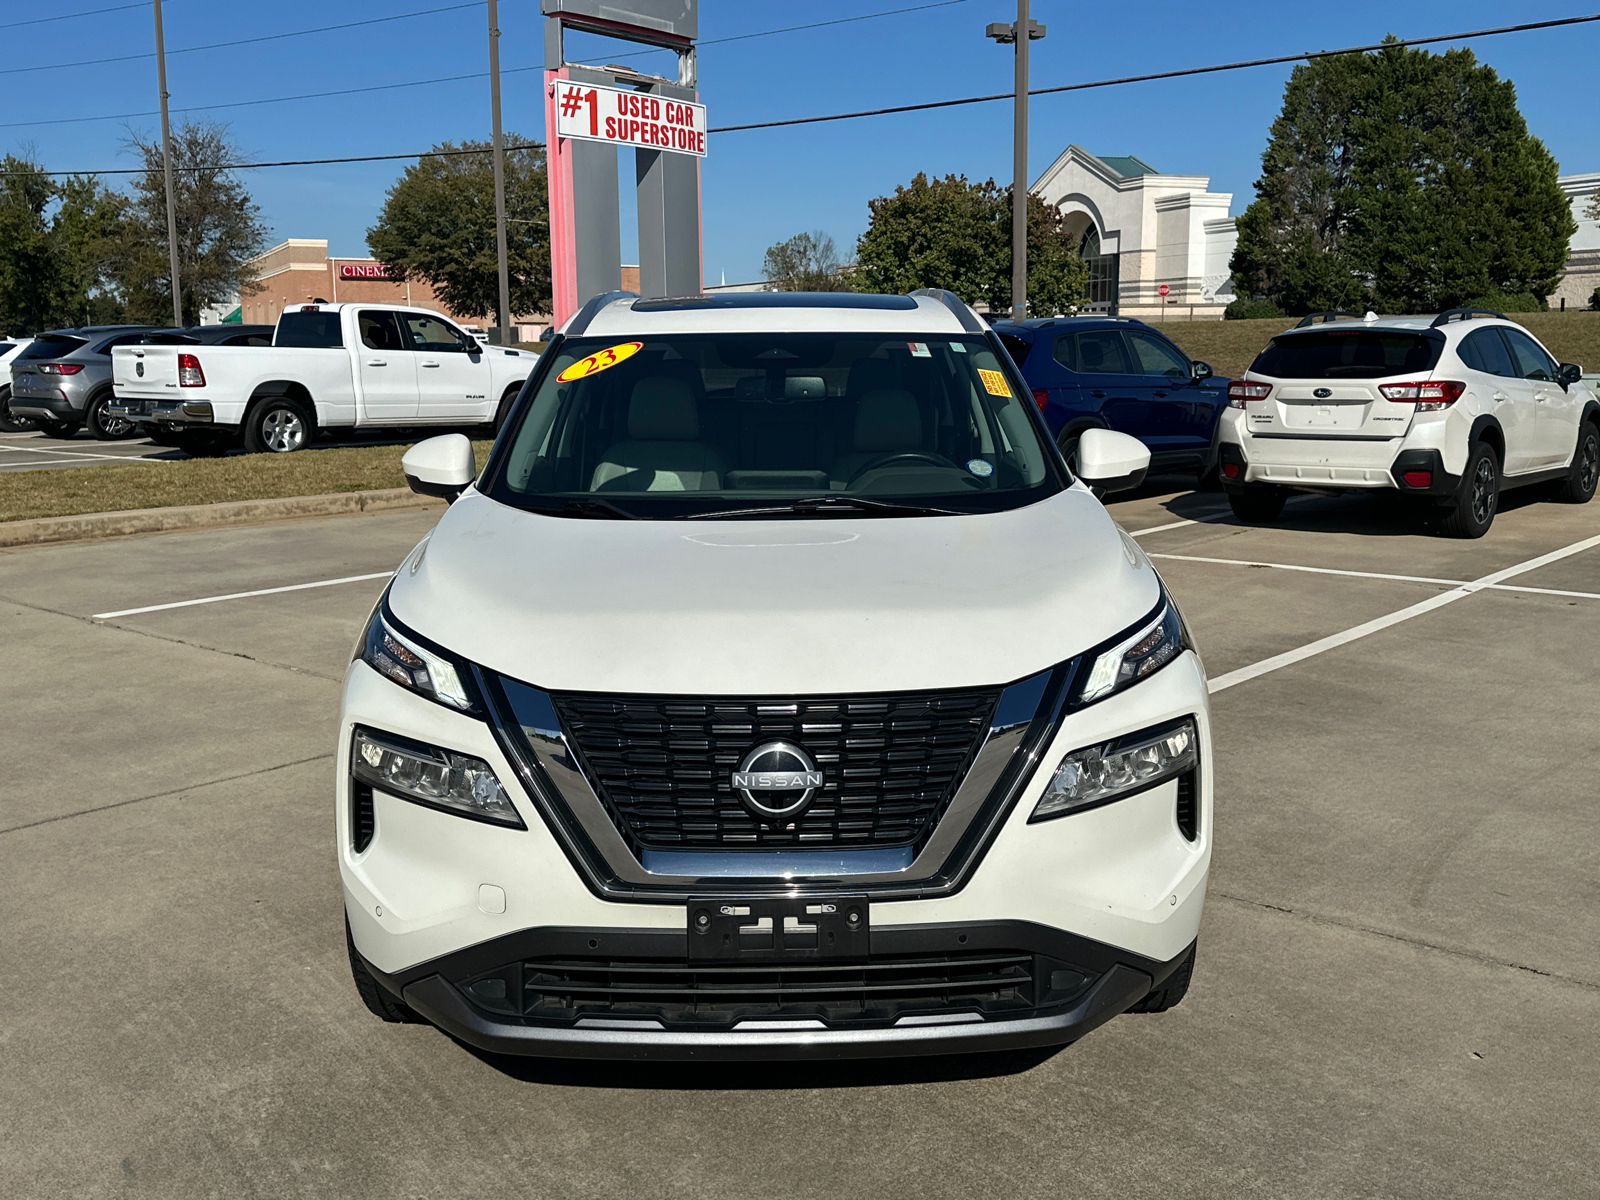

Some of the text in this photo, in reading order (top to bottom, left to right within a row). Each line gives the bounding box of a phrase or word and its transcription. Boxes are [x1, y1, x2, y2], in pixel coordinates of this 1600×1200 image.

[560, 86, 599, 136] #1
[617, 94, 694, 128] USED CAR
[605, 116, 704, 152] SUPERSTORE
[582, 349, 617, 375] 23
[735, 774, 820, 787] NISSAN
